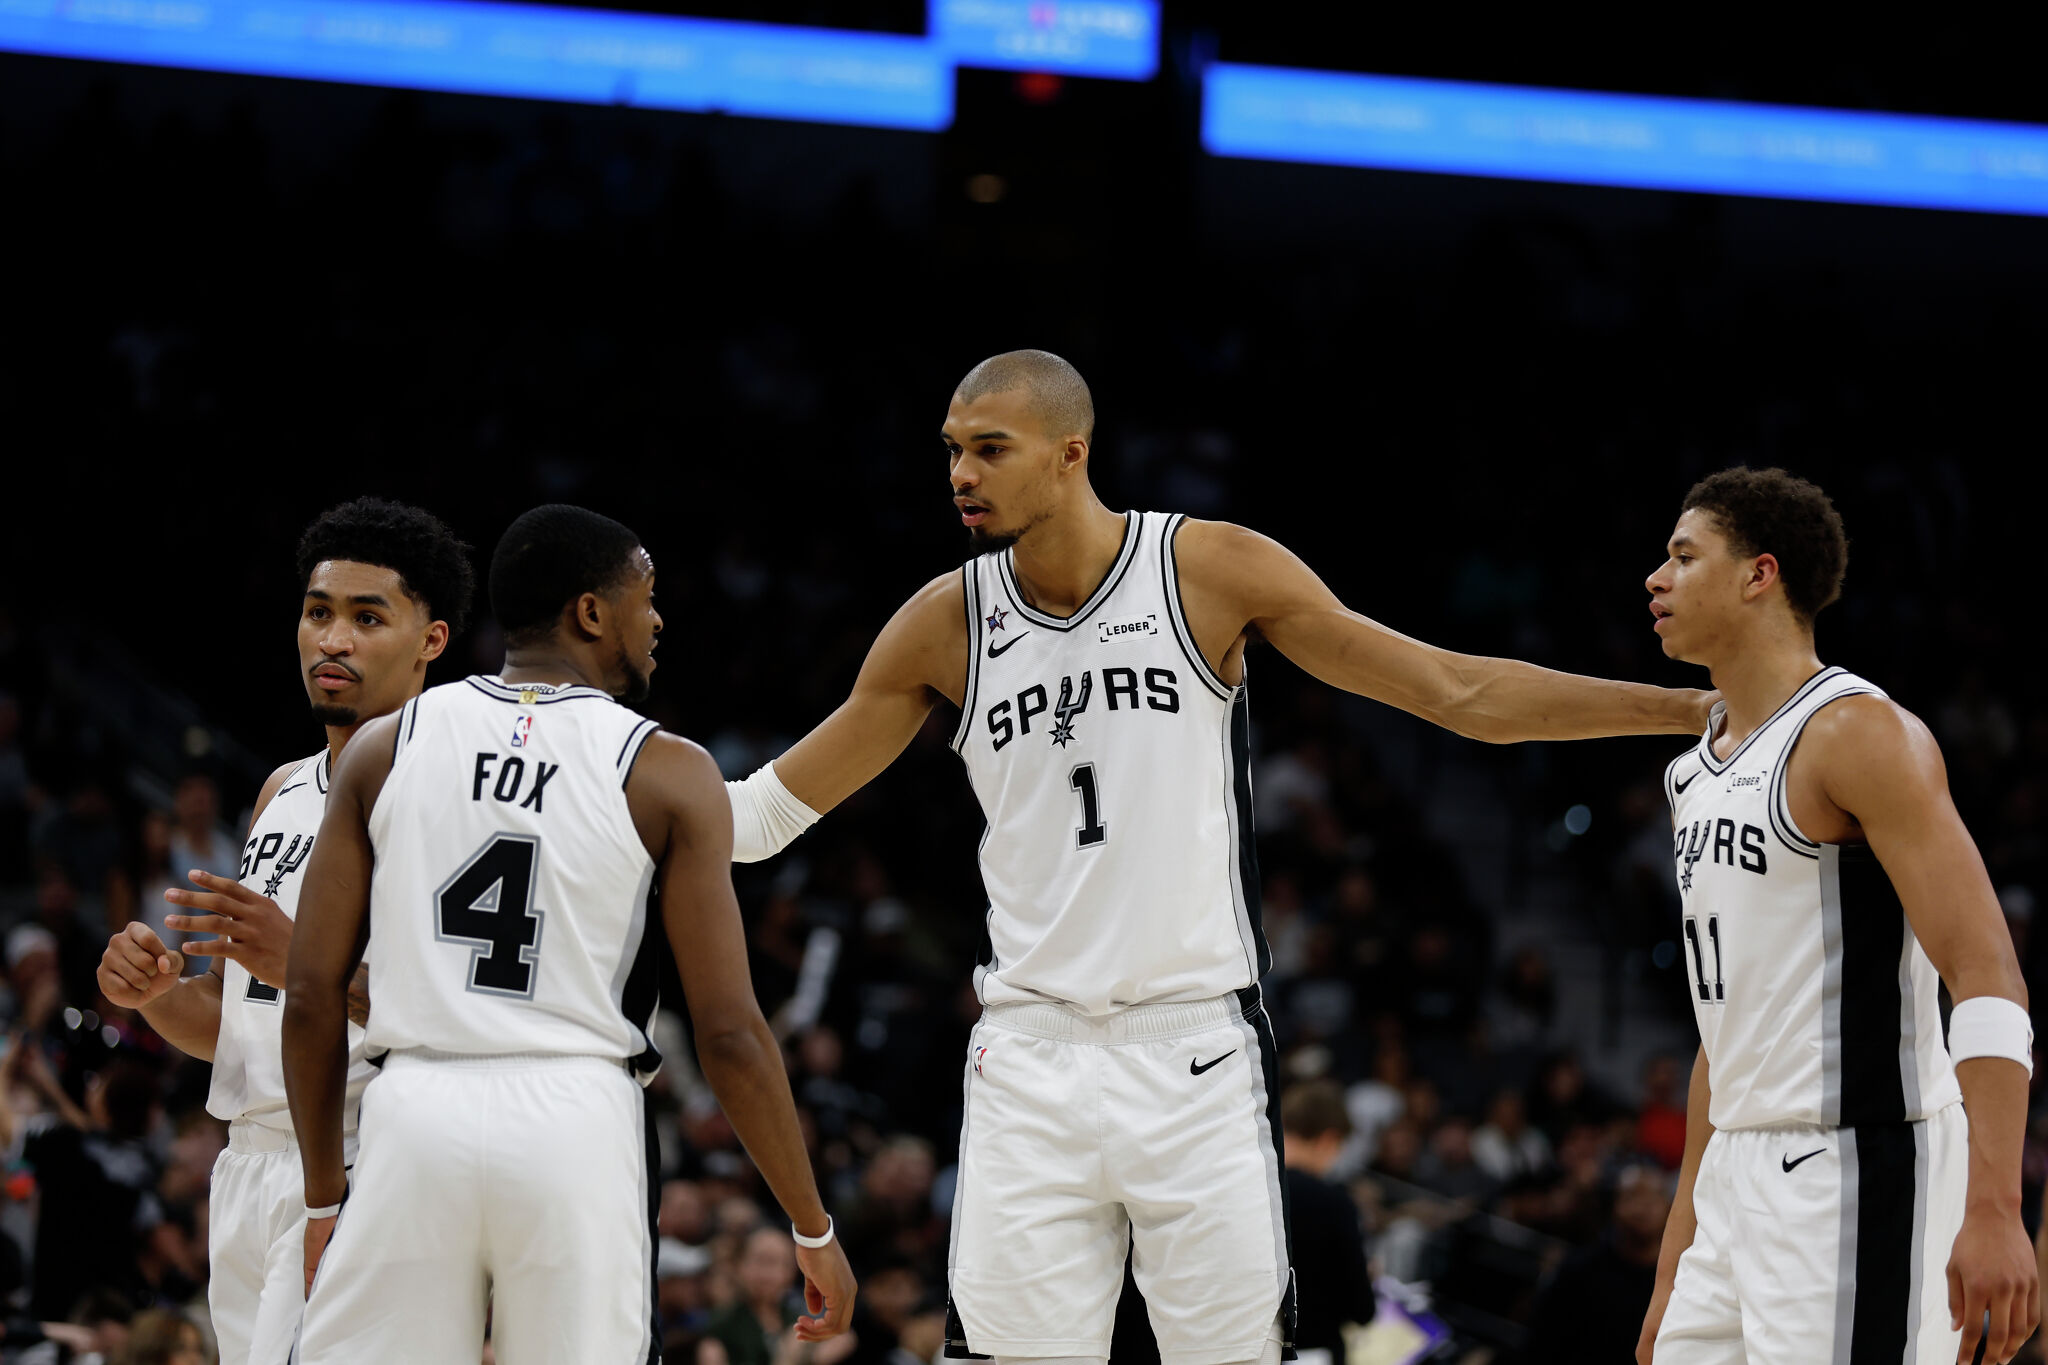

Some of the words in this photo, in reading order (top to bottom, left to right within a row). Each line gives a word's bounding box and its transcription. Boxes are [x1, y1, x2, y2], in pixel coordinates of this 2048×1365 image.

[1106, 622, 1150, 636] LEDGER
[987, 667, 1180, 752] SPURS
[472, 752, 559, 813] FOX
[1068, 761, 1107, 851] 1
[1732, 776, 1761, 787] LEDGER
[239, 832, 315, 898] SPU
[1676, 818, 1768, 896] PURS
[432, 831, 545, 1001] 4
[1683, 912, 1726, 1005] 11
